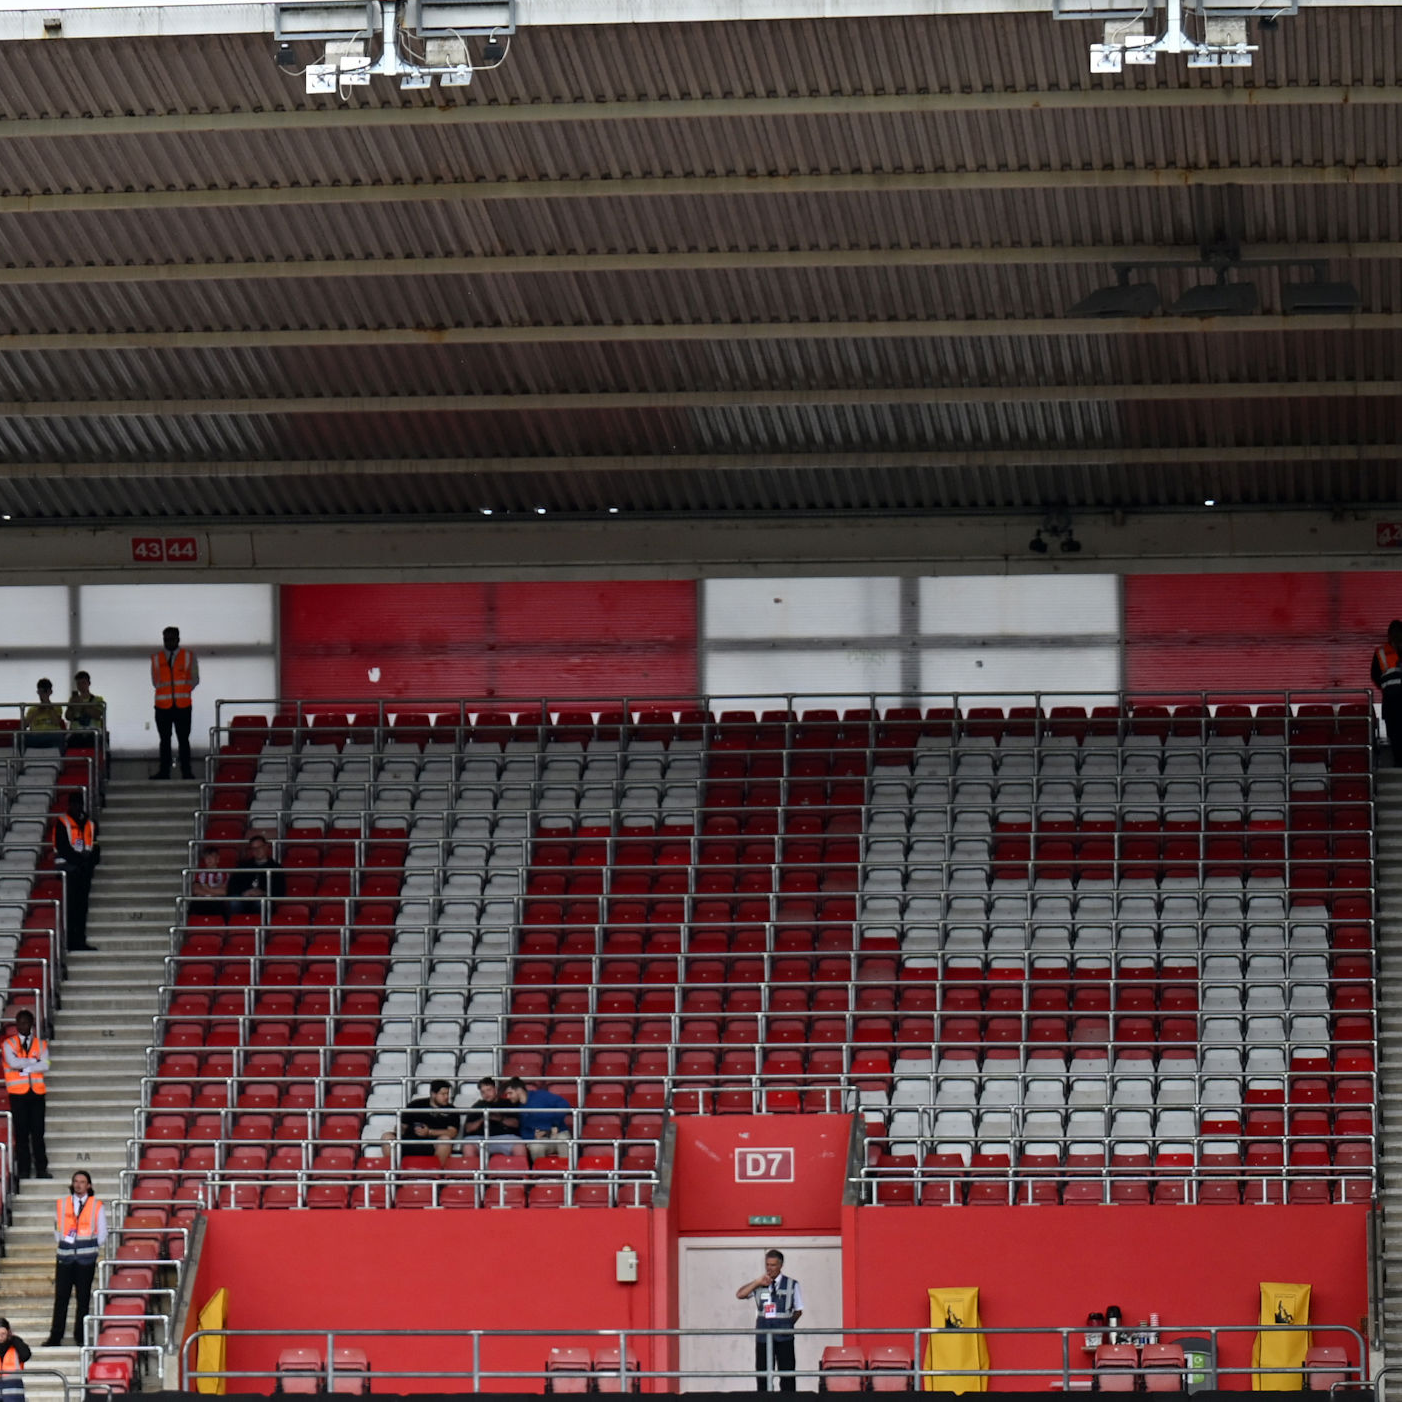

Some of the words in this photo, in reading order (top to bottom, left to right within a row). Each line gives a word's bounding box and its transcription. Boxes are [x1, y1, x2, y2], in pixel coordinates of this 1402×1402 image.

[135, 542, 161, 558] 43
[168, 542, 195, 557] 44
[745, 1153, 783, 1176] D7
